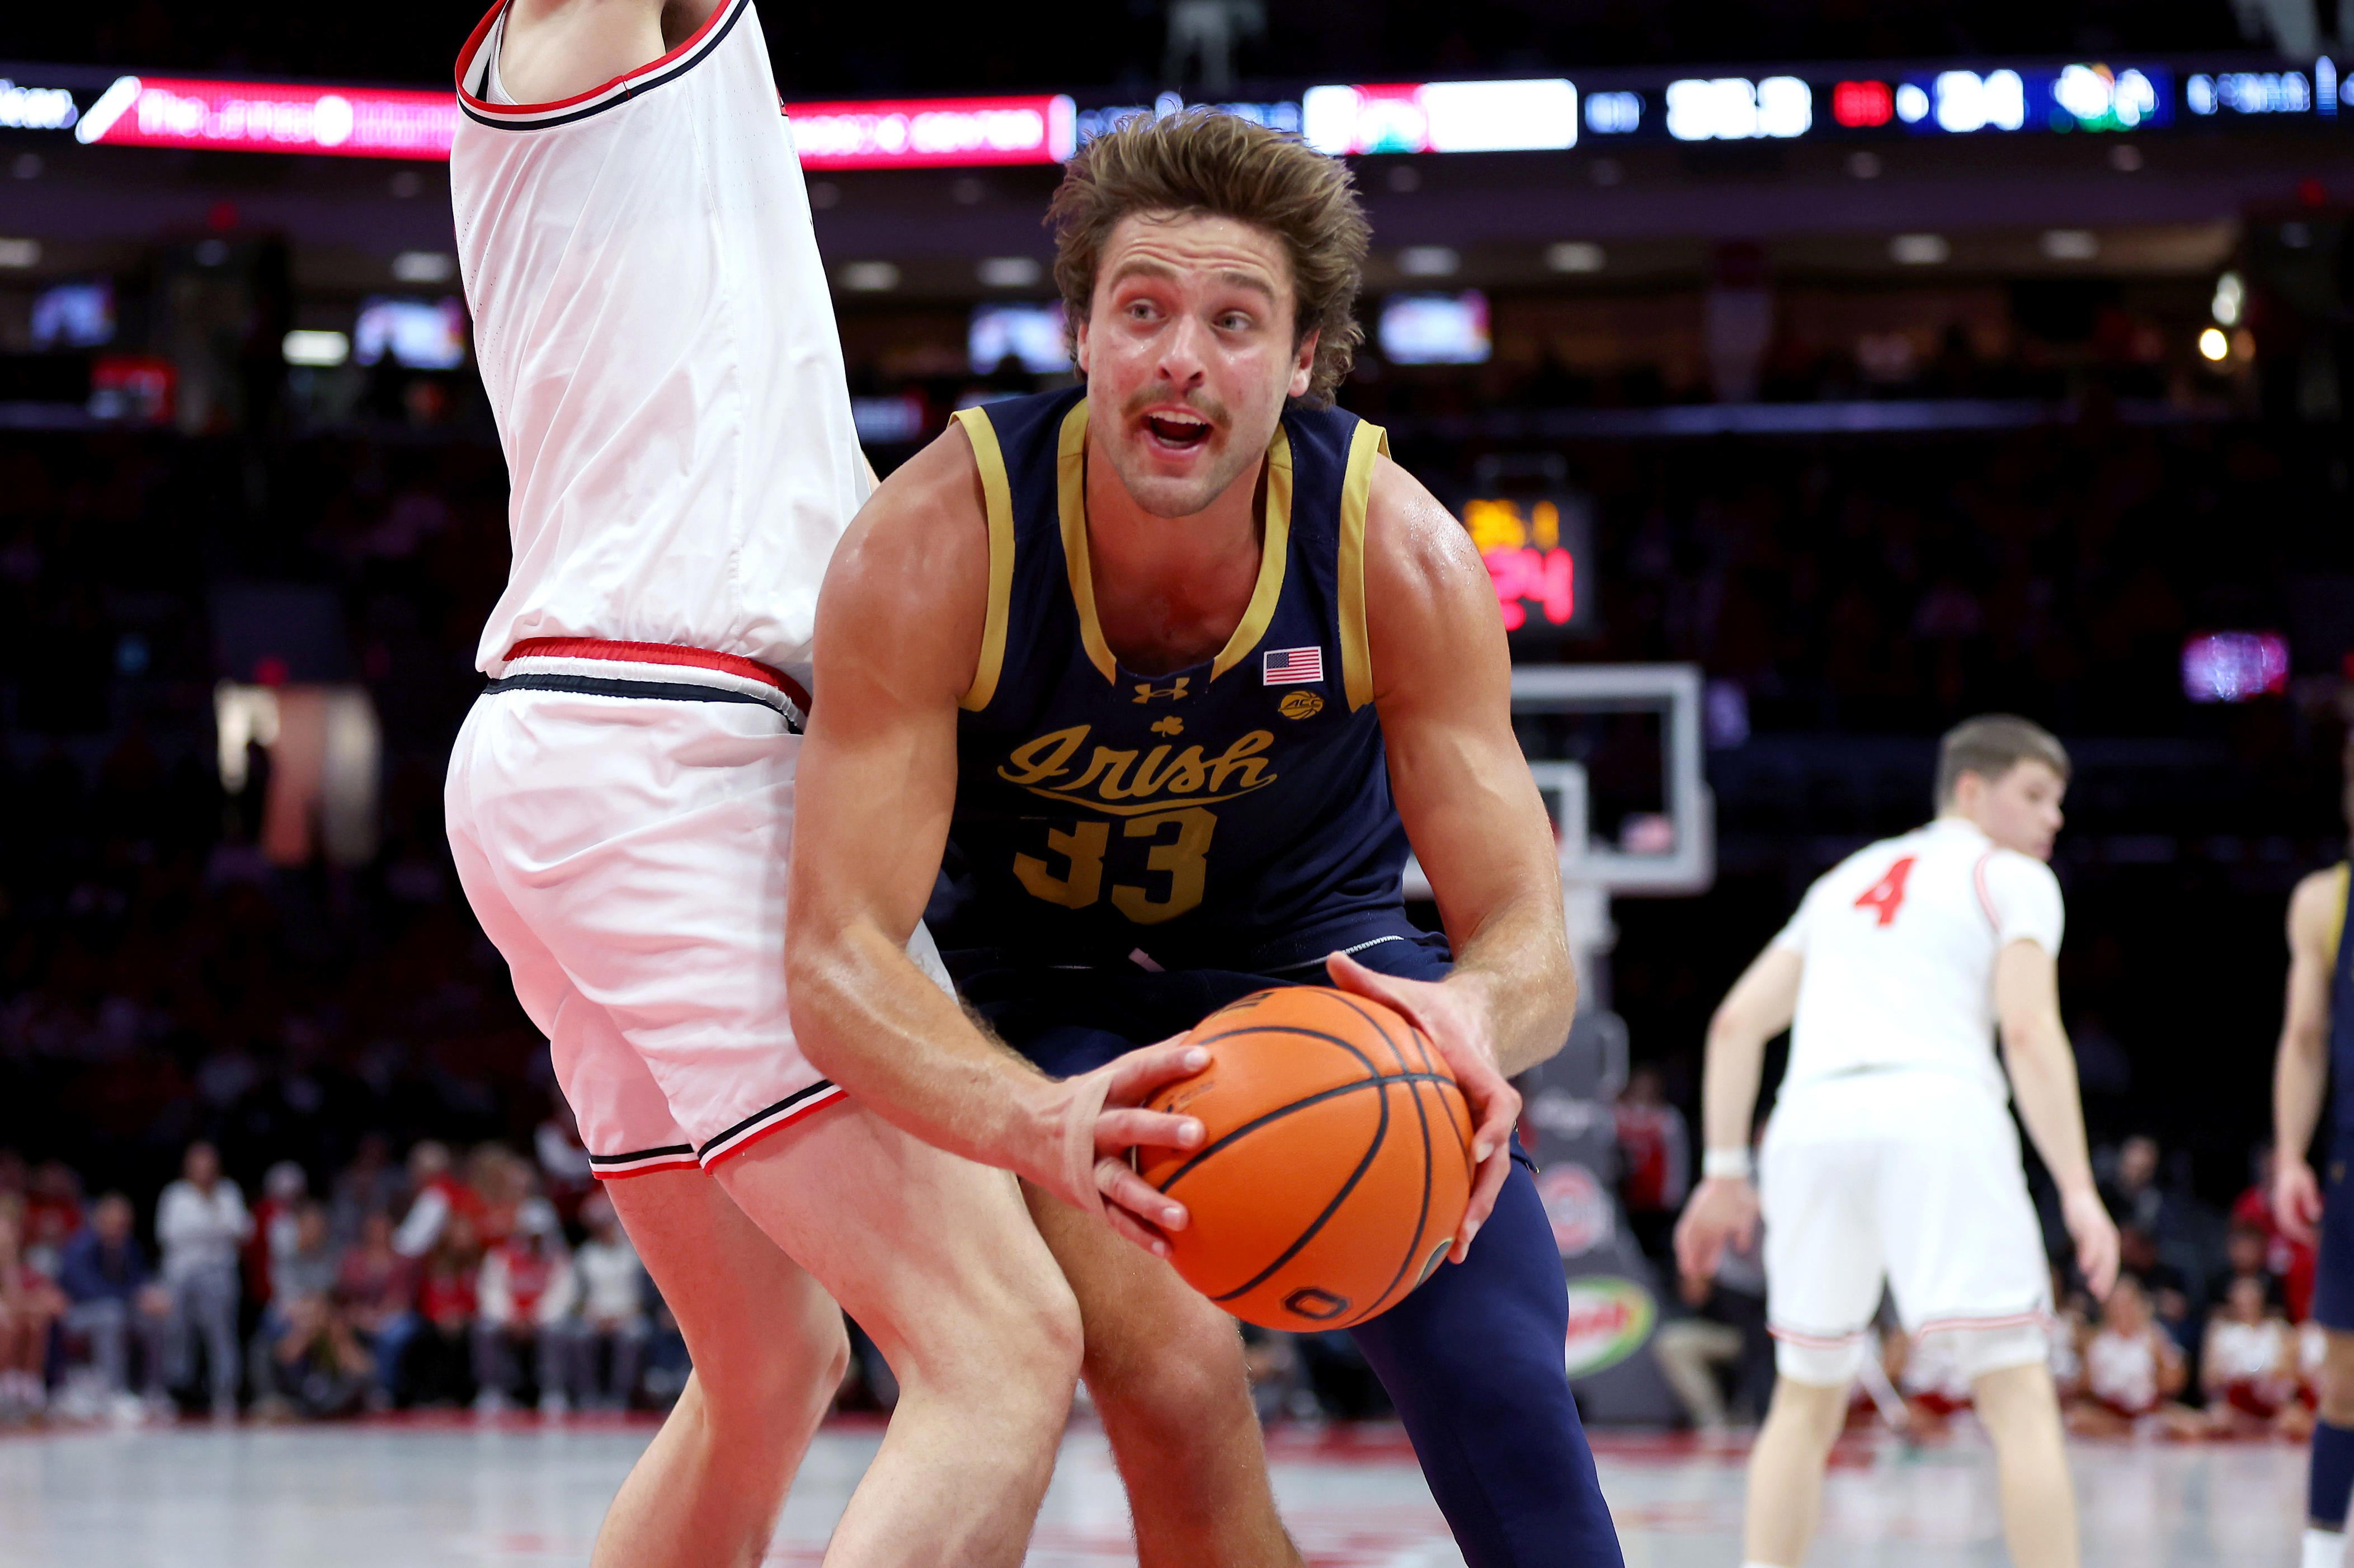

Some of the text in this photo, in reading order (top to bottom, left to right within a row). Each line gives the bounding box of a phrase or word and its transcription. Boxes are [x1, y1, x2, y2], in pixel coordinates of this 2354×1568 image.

[1282, 699, 1324, 710] ACC
[997, 724, 1278, 808] Irish
[1013, 807, 1217, 925] 33
[1853, 855, 1917, 927] 4
